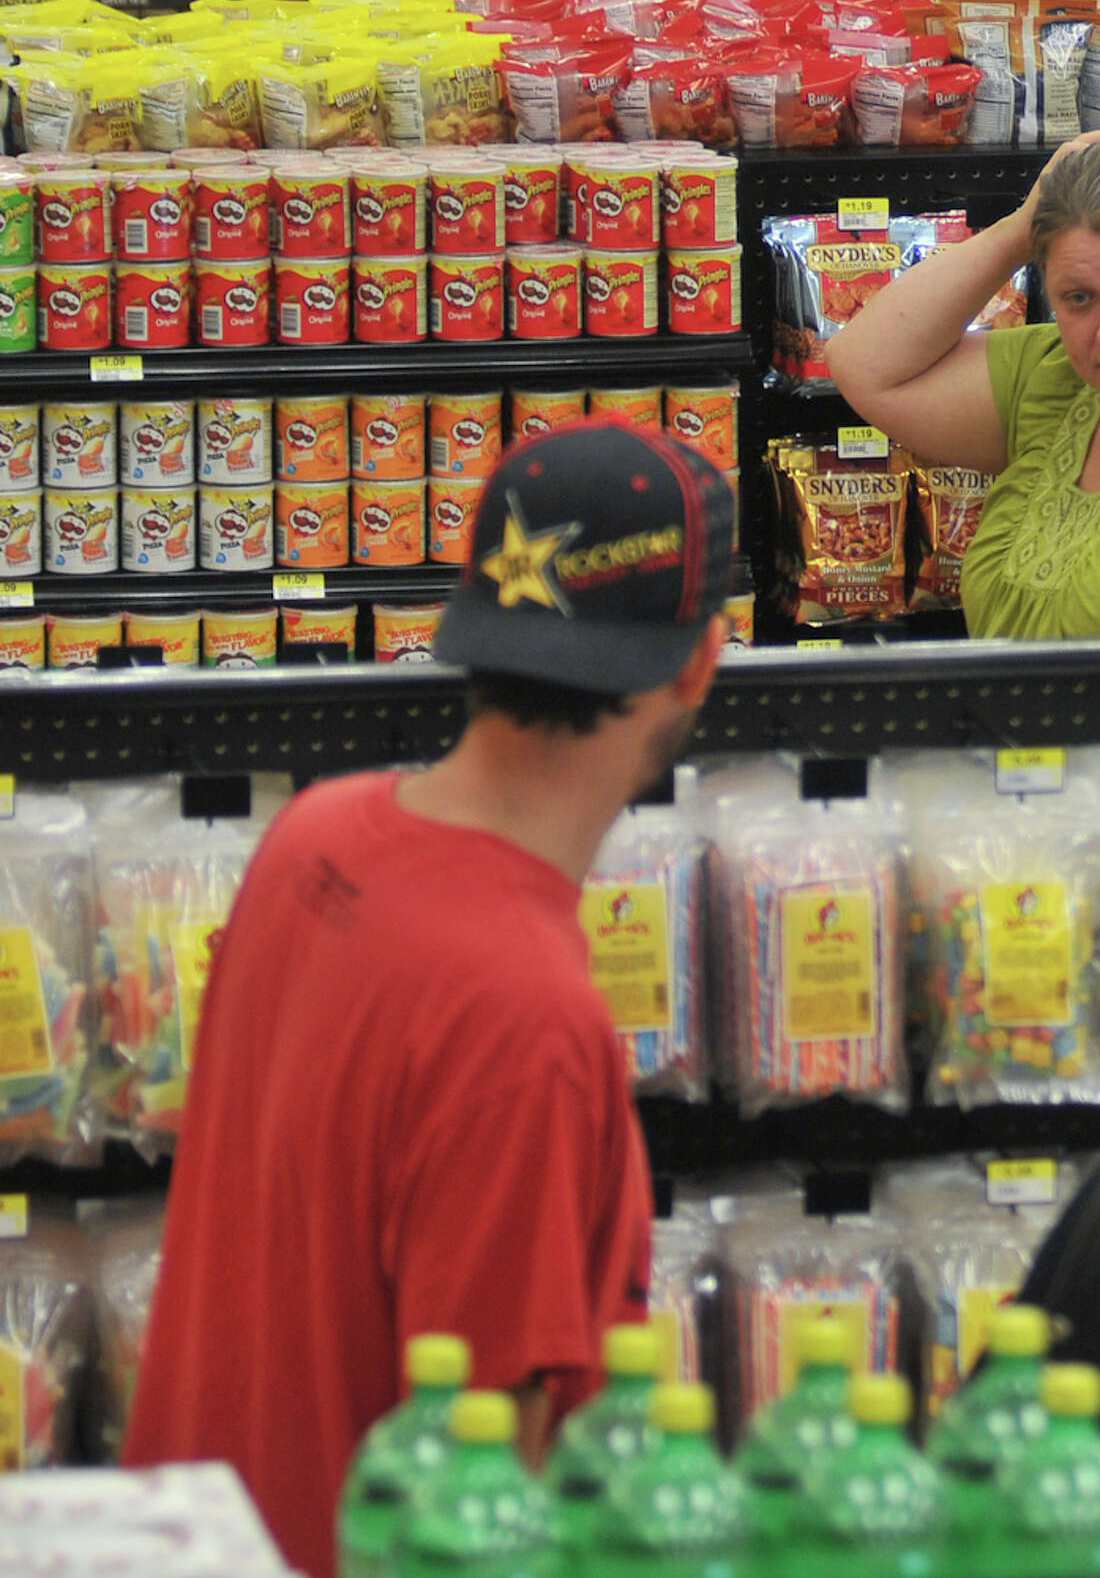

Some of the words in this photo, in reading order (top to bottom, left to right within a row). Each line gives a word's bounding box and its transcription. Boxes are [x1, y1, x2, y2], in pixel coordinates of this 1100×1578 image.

[811, 246, 896, 264] SNYDER'S
[810, 477, 897, 495] SNYDER'S
[932, 471, 998, 489] SNYDE
[939, 556, 963, 566] Hone
[826, 591, 889, 604] PIECES
